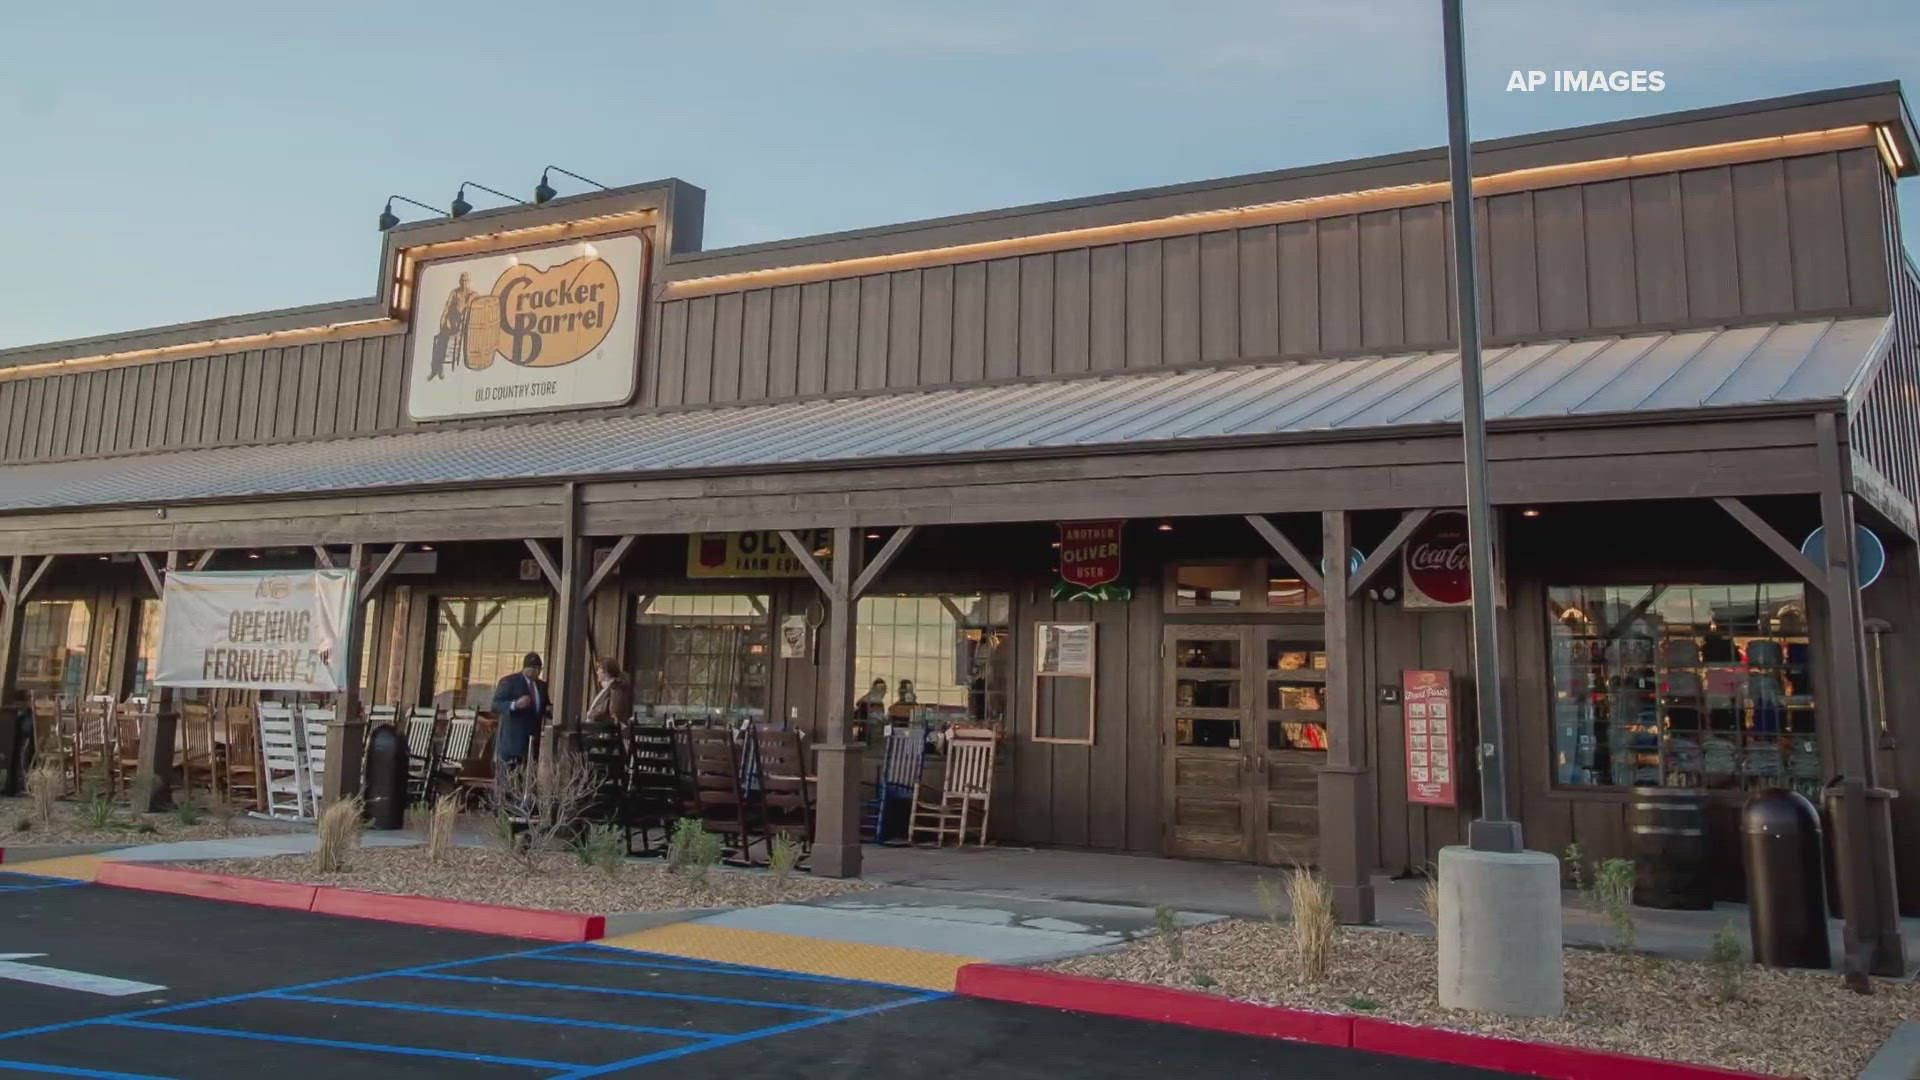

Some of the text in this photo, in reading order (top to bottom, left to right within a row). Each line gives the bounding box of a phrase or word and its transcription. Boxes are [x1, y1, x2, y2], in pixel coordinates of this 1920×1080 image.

[500, 276, 605, 336] Cracker
[511, 301, 604, 365] Barrel
[475, 381, 558, 401] OLD COUNTRY STORE
[738, 530, 829, 554] OLIVE
[1066, 528, 1114, 539] ANOTHER
[736, 556, 769, 571] FARM
[1063, 543, 1118, 562] OLIVER
[1077, 567, 1104, 578] USER
[228, 609, 312, 642] OPENING
[202, 647, 300, 683] FEBRUARY
